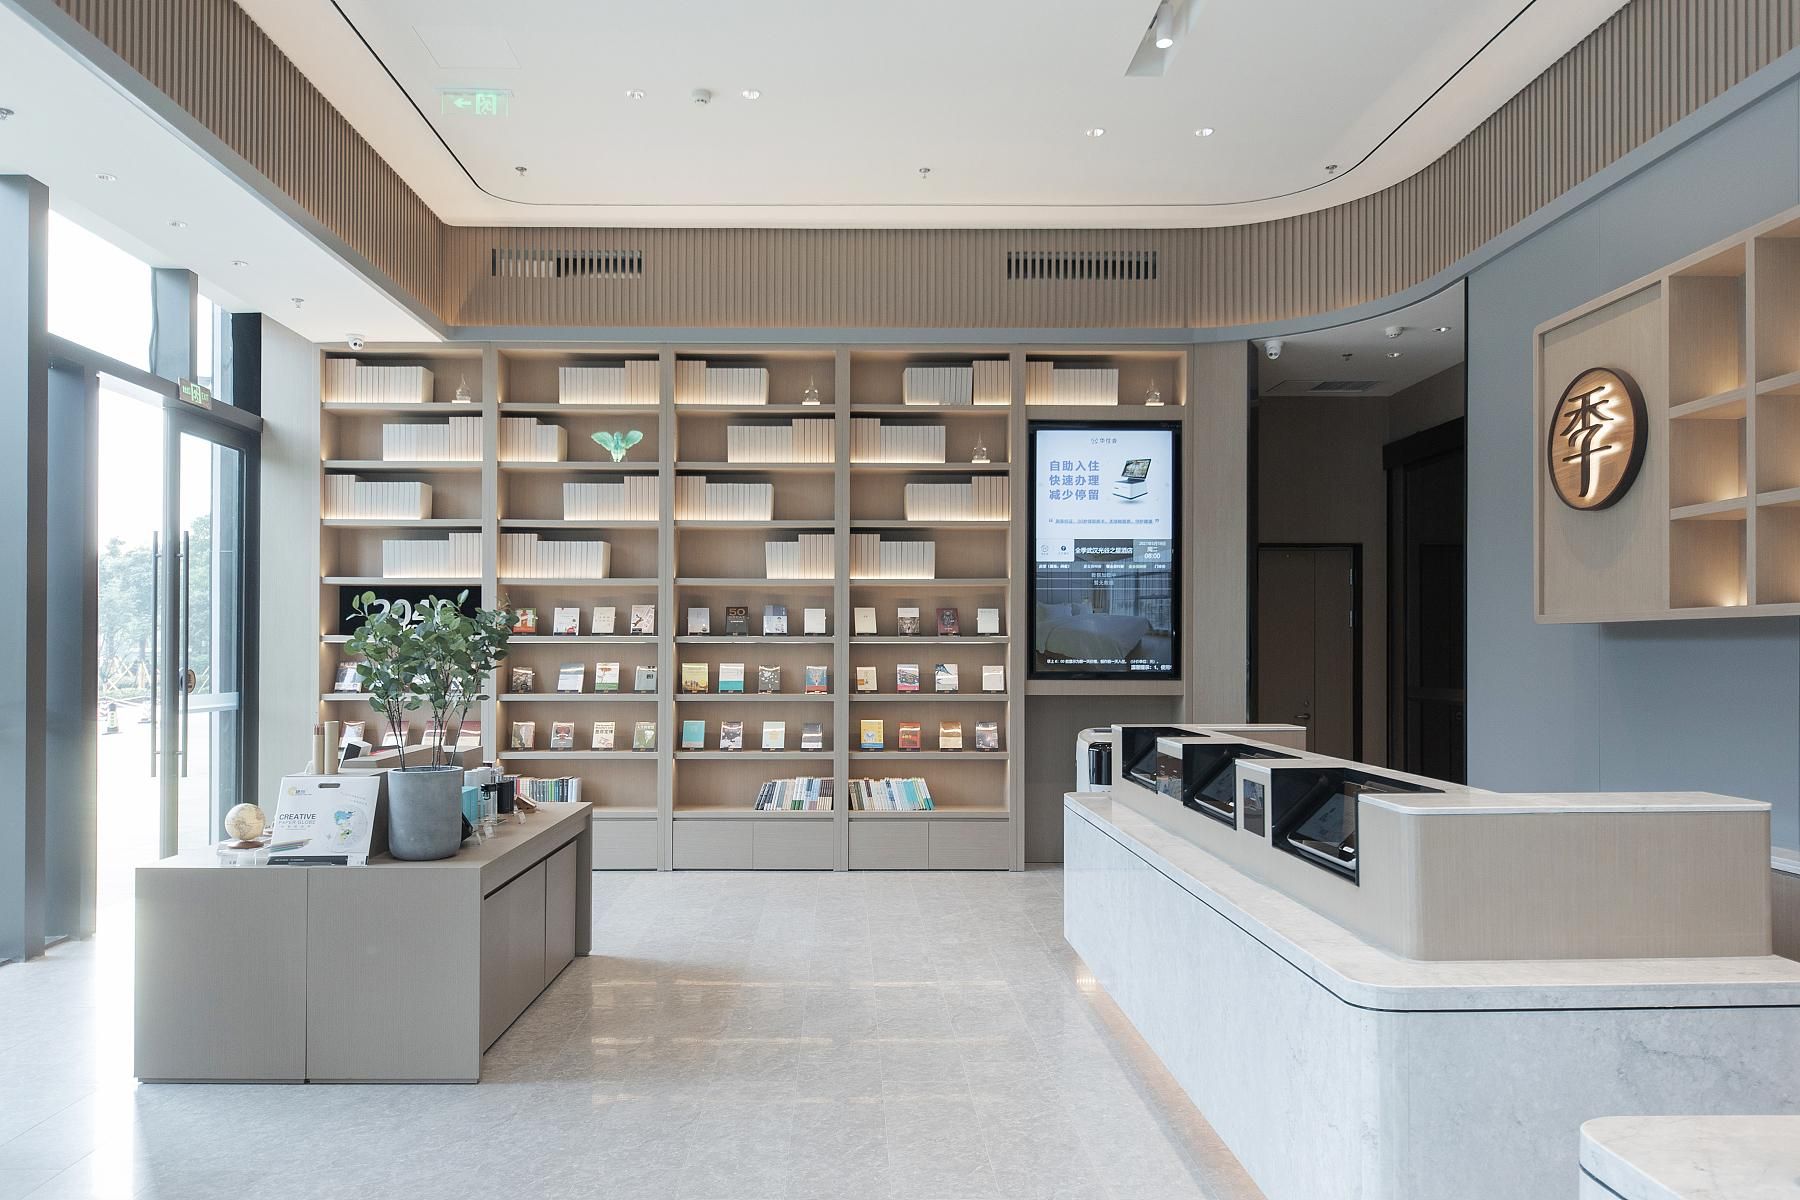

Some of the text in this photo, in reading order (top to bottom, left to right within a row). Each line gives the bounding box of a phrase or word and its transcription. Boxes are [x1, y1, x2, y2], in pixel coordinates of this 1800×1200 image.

[1560, 386, 1614, 497] 季
[1049, 460, 1100, 472] 自助入住
[1049, 474, 1100, 486] 快速办理
[1049, 489, 1099, 501] 减少停留
[729, 608, 746, 616] 50
